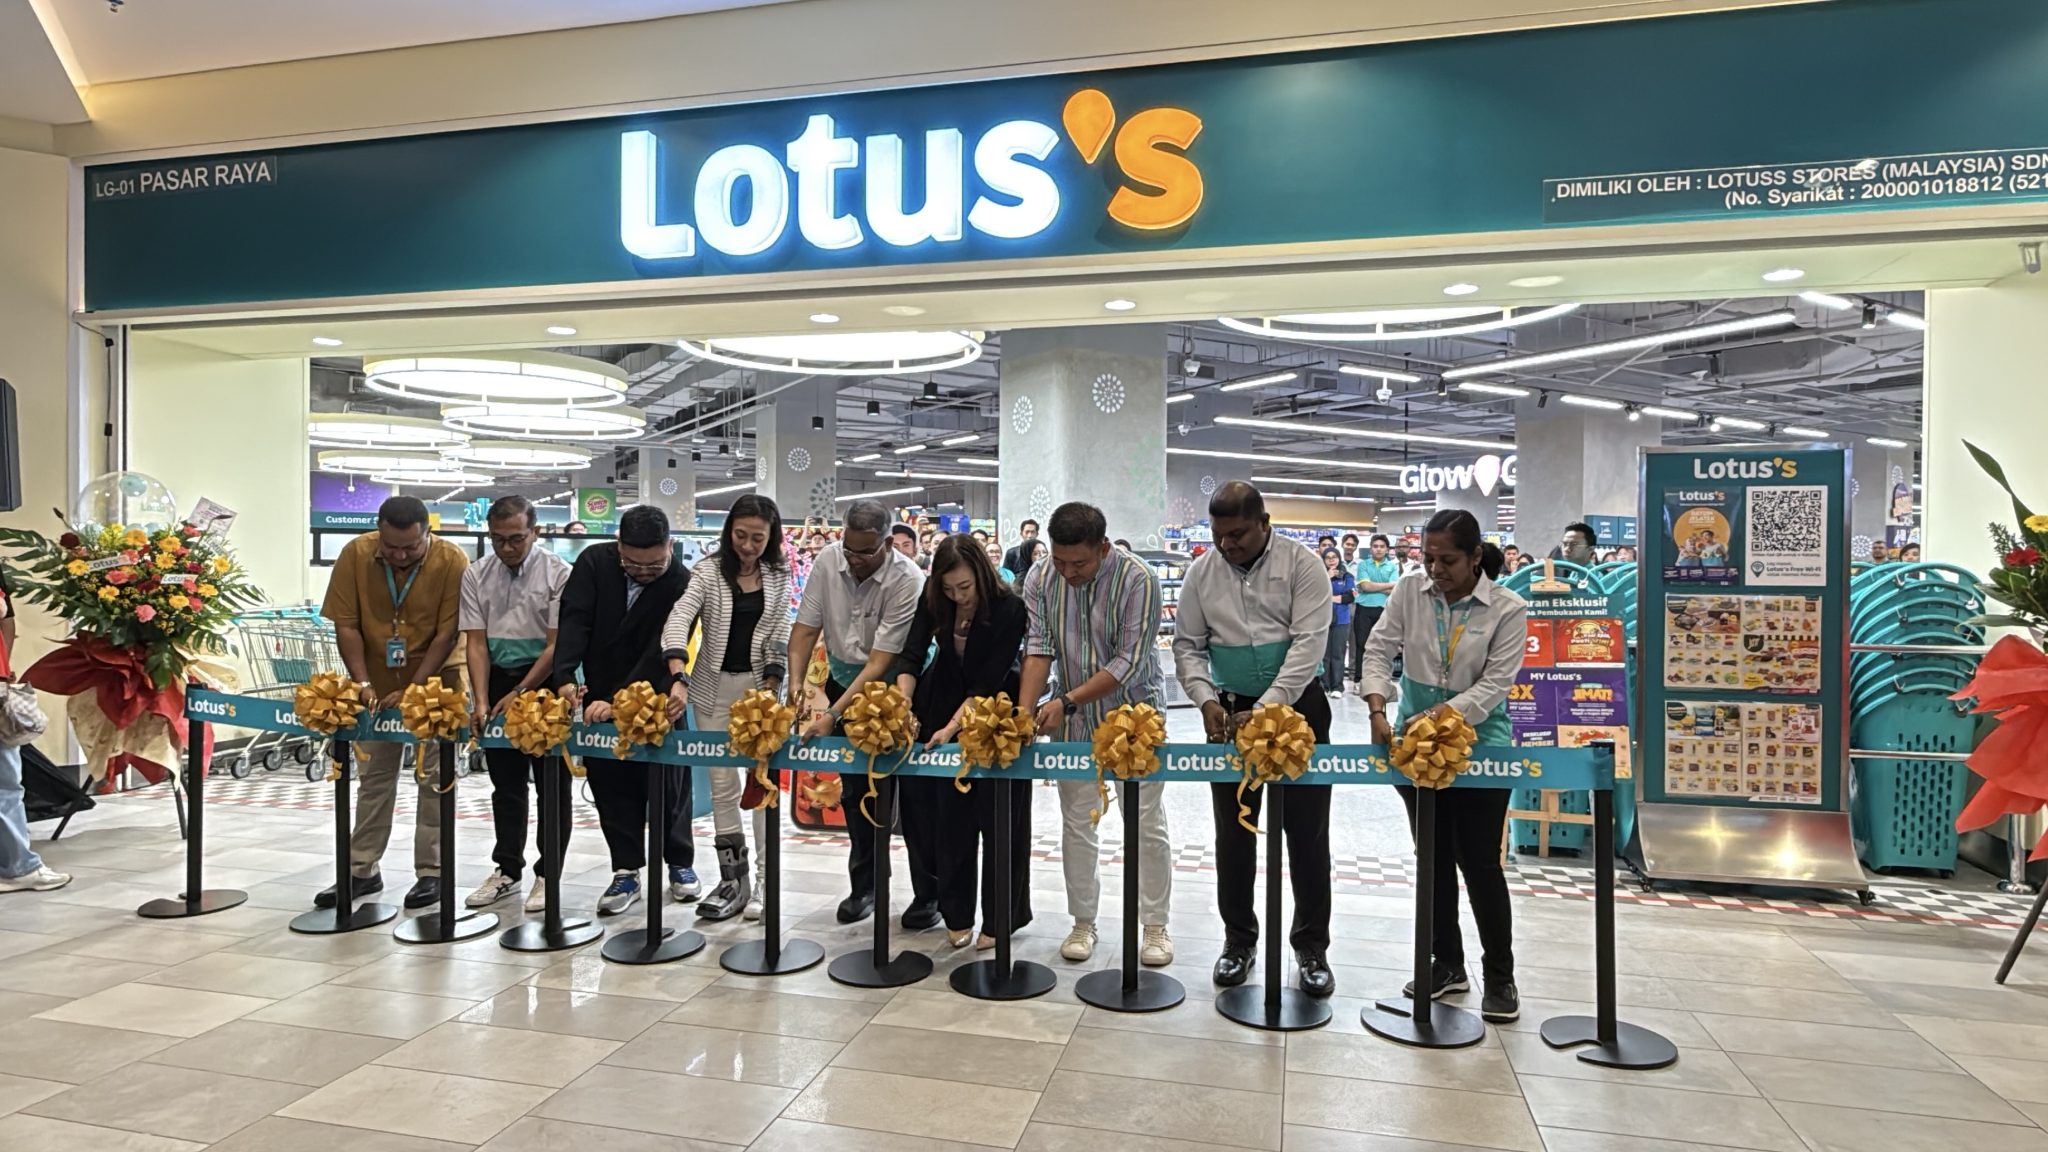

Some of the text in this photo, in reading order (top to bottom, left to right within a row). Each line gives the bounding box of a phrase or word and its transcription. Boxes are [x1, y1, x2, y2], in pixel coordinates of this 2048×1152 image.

[95, 161, 272, 198] LG-01 PASAR RAYA
[619, 88, 1204, 260] Lotus's
[1556, 179, 1632, 199] DIMILIKI
[1637, 175, 1691, 194] OLEH
[1707, 170, 1787, 189] LOTUSS
[1791, 164, 1878, 185] STORES
[1882, 155, 2005, 183] (MALAYSIA)
[1724, 190, 1762, 210] (No.
[1767, 186, 1845, 208] Syarikat
[1860, 175, 2003, 200] 200001018812
[1694, 457, 1797, 479] Lotus's
[1400, 462, 1476, 494] Glow
[1680, 490, 1725, 501] Lotus's
[325, 515, 372, 524] Customer
[1537, 608, 1583, 616] Pembukaan
[1584, 608, 1608, 616] Kami!
[1552, 597, 1608, 608] Eksklusif
[1530, 673, 1582, 681] MY Lotus's
[188, 697, 236, 718] Lotus's
[677, 740, 739, 757] Lotus's
[788, 744, 856, 764] Lotus's
[1166, 753, 1243, 772] Lotus's
[1307, 755, 1389, 774] Lotus's
[1456, 758, 1543, 777] otus's
